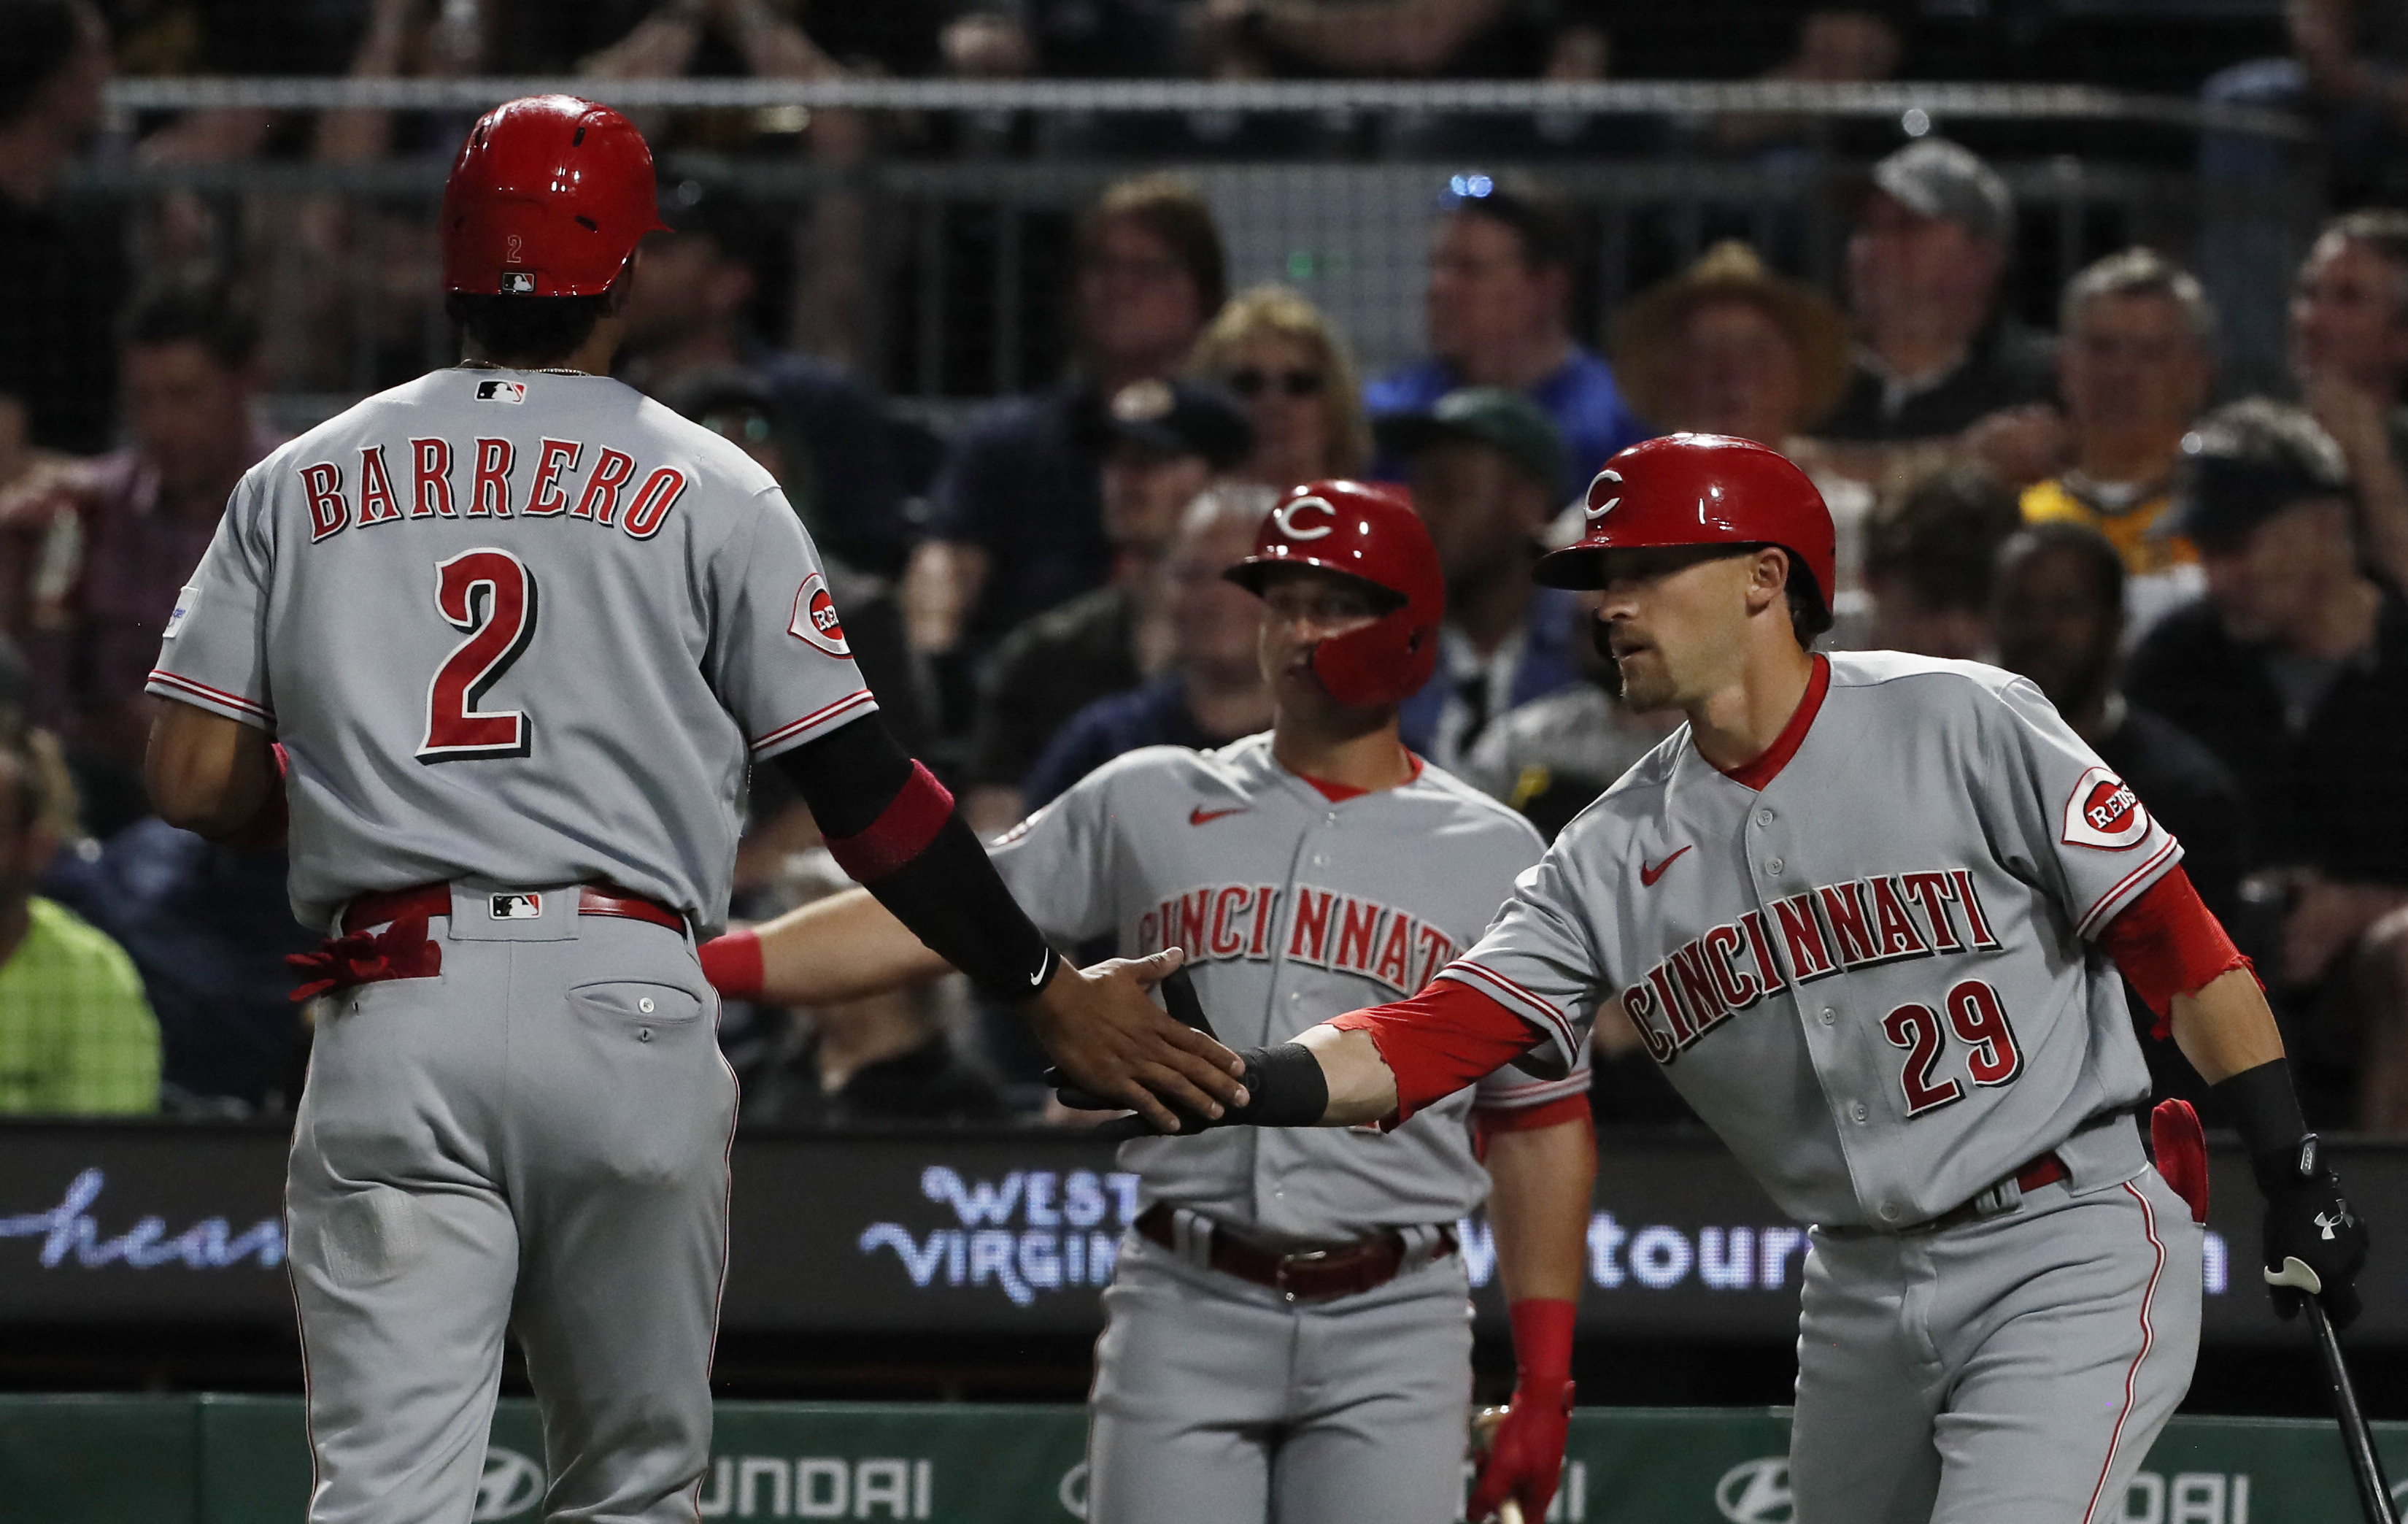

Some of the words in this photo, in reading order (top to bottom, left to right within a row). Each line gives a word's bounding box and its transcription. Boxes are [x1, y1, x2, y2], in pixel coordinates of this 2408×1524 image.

[506, 234, 522, 263] 2
[298, 435, 689, 544] BARRERO
[1274, 496, 1336, 540] C
[1584, 469, 1623, 520] C
[811, 604, 840, 631] RE
[414, 547, 539, 766] 2
[2088, 783, 2137, 829] REDS
[1135, 880, 1465, 998] CINCINNAT
[1621, 868, 2003, 1064] CINCINNATI
[1880, 978, 2023, 1118] 29
[921, 1166, 1141, 1227] WEST
[698, 1456, 932, 1520] UNDAI
